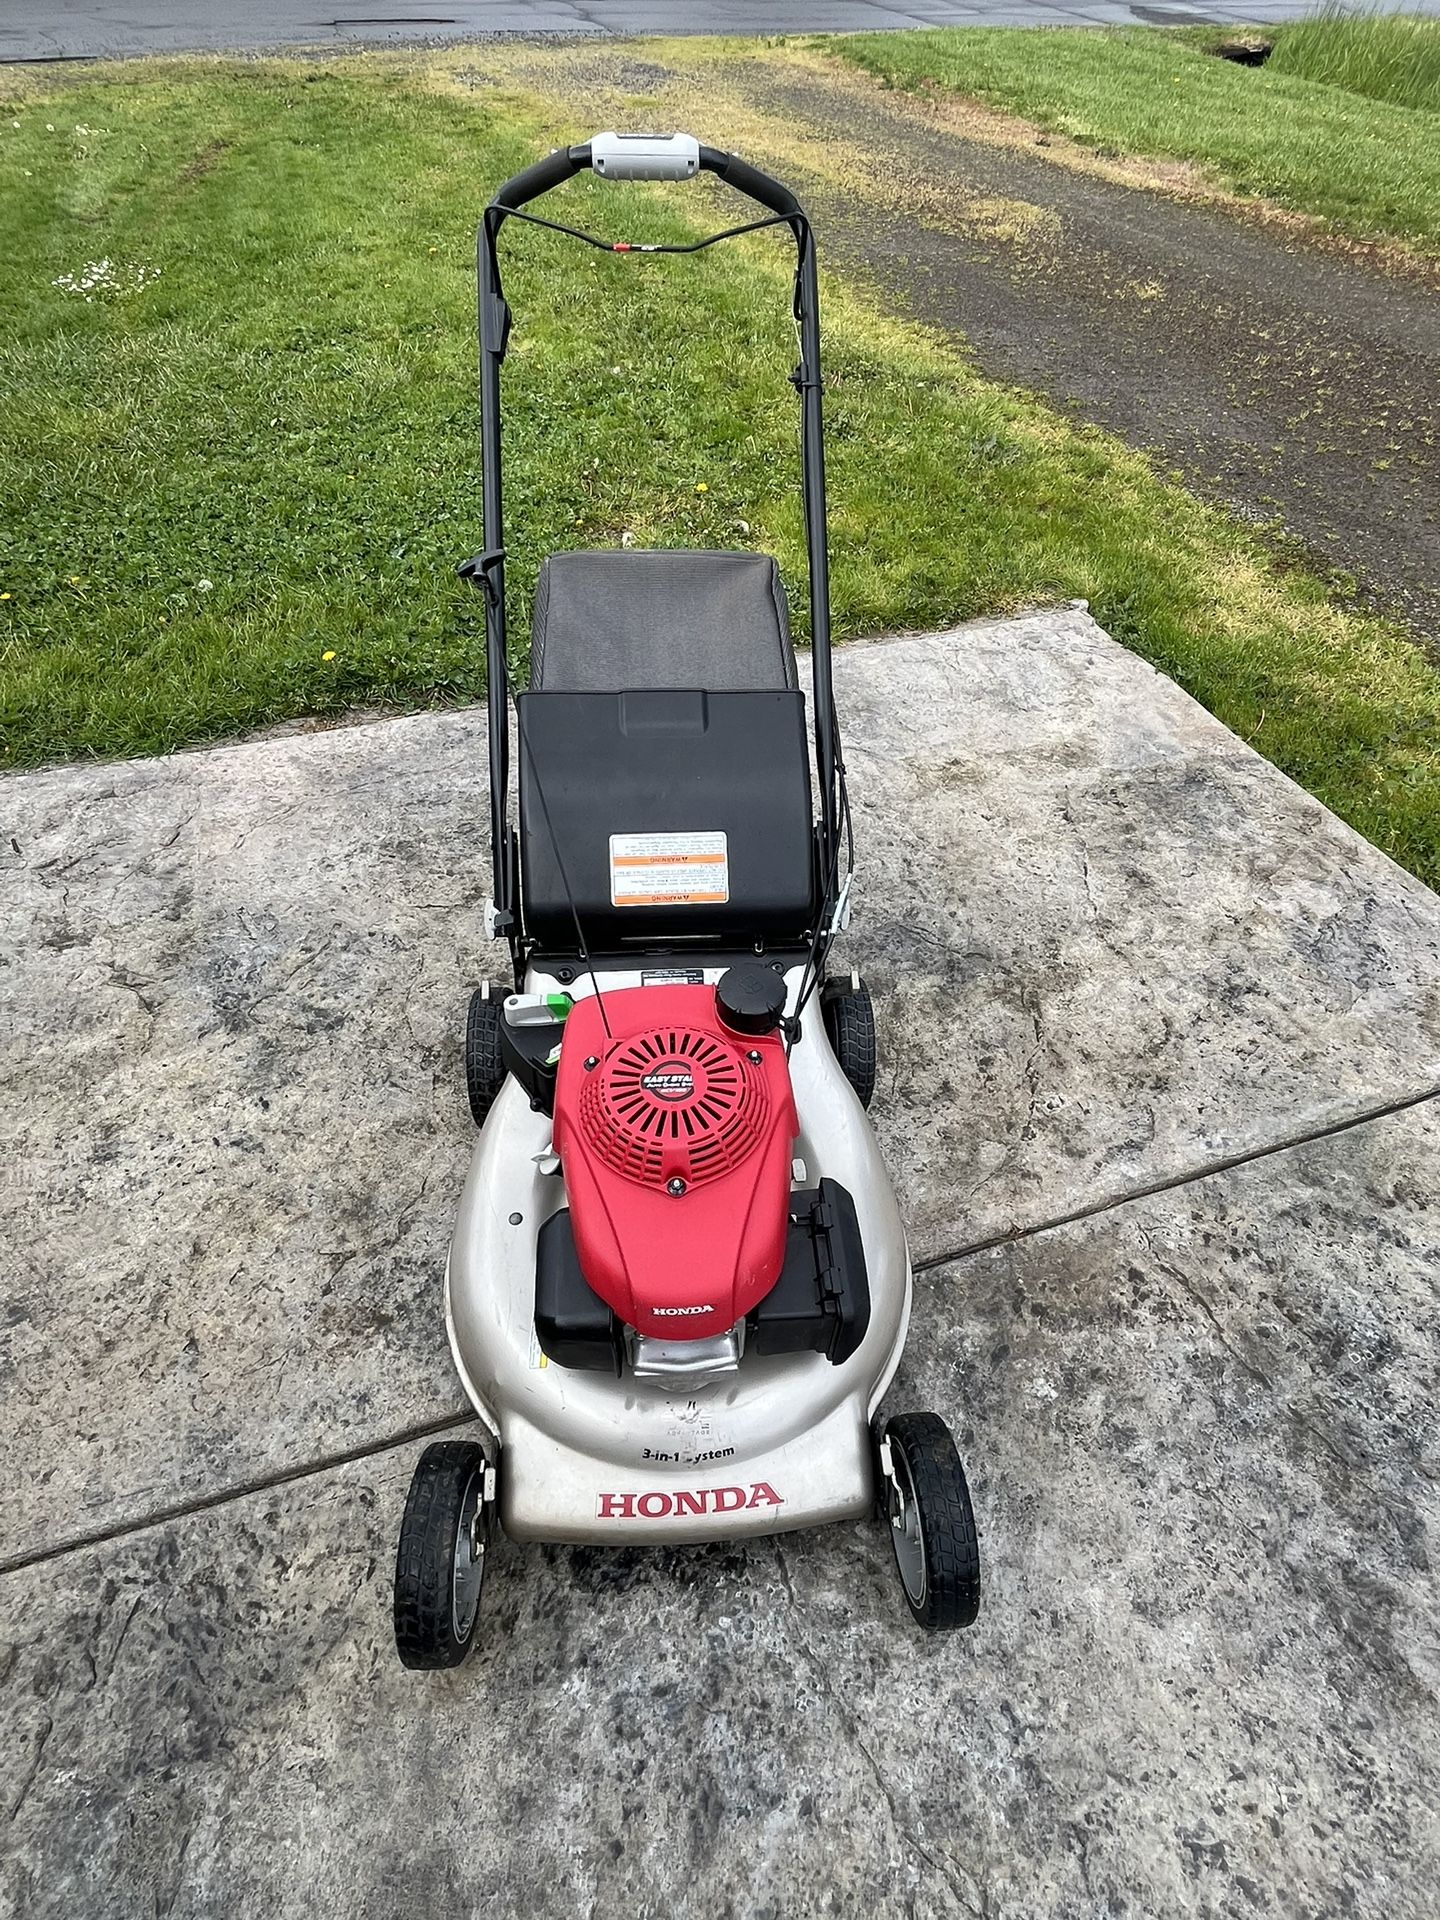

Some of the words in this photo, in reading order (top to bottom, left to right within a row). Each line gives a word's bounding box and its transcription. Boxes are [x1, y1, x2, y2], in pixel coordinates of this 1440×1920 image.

[644, 1075, 671, 1083] EASY
[652, 1304, 715, 1316] HONDA
[642, 1448, 680, 1462] 3-in-1
[683, 1446, 735, 1465] ystem
[597, 1481, 785, 1518] HONDA
